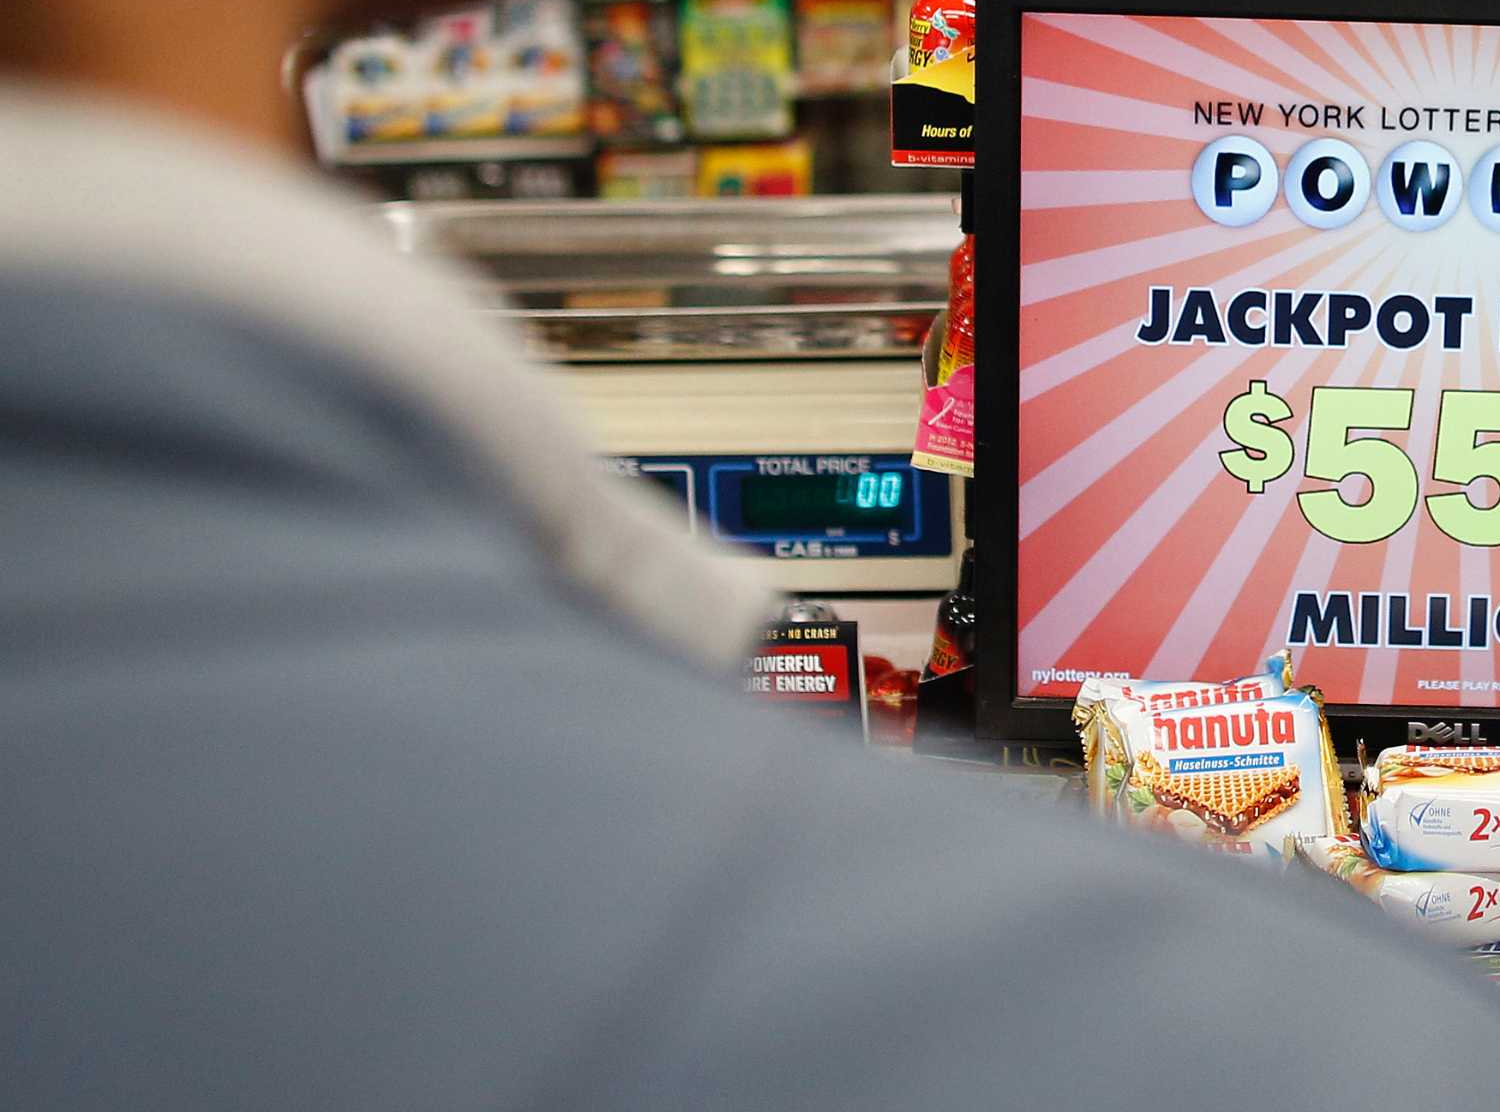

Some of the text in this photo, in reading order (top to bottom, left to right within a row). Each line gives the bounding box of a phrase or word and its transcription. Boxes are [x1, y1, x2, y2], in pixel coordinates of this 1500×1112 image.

[1193, 101, 1265, 127] NEW
[1278, 103, 1364, 130] YORK
[921, 124, 974, 139] Hours of
[1138, 287, 1474, 349] JACKPOT
[756, 456, 872, 476] TOTAL PRICE
[774, 540, 823, 557] CAS
[787, 628, 801, 640] NO
[804, 627, 837, 640] CRASH
[775, 674, 838, 693] ENERGY
[1417, 679, 1460, 691] PLEASE
[1461, 680, 1491, 692] PLAY
[1154, 701, 1297, 752] hanuta
[1407, 721, 1488, 743] DELL
[1173, 753, 1281, 772] Haselnuss-Schnitte
[1428, 807, 1451, 818] OHNE
[1467, 886, 1499, 922] 2x
